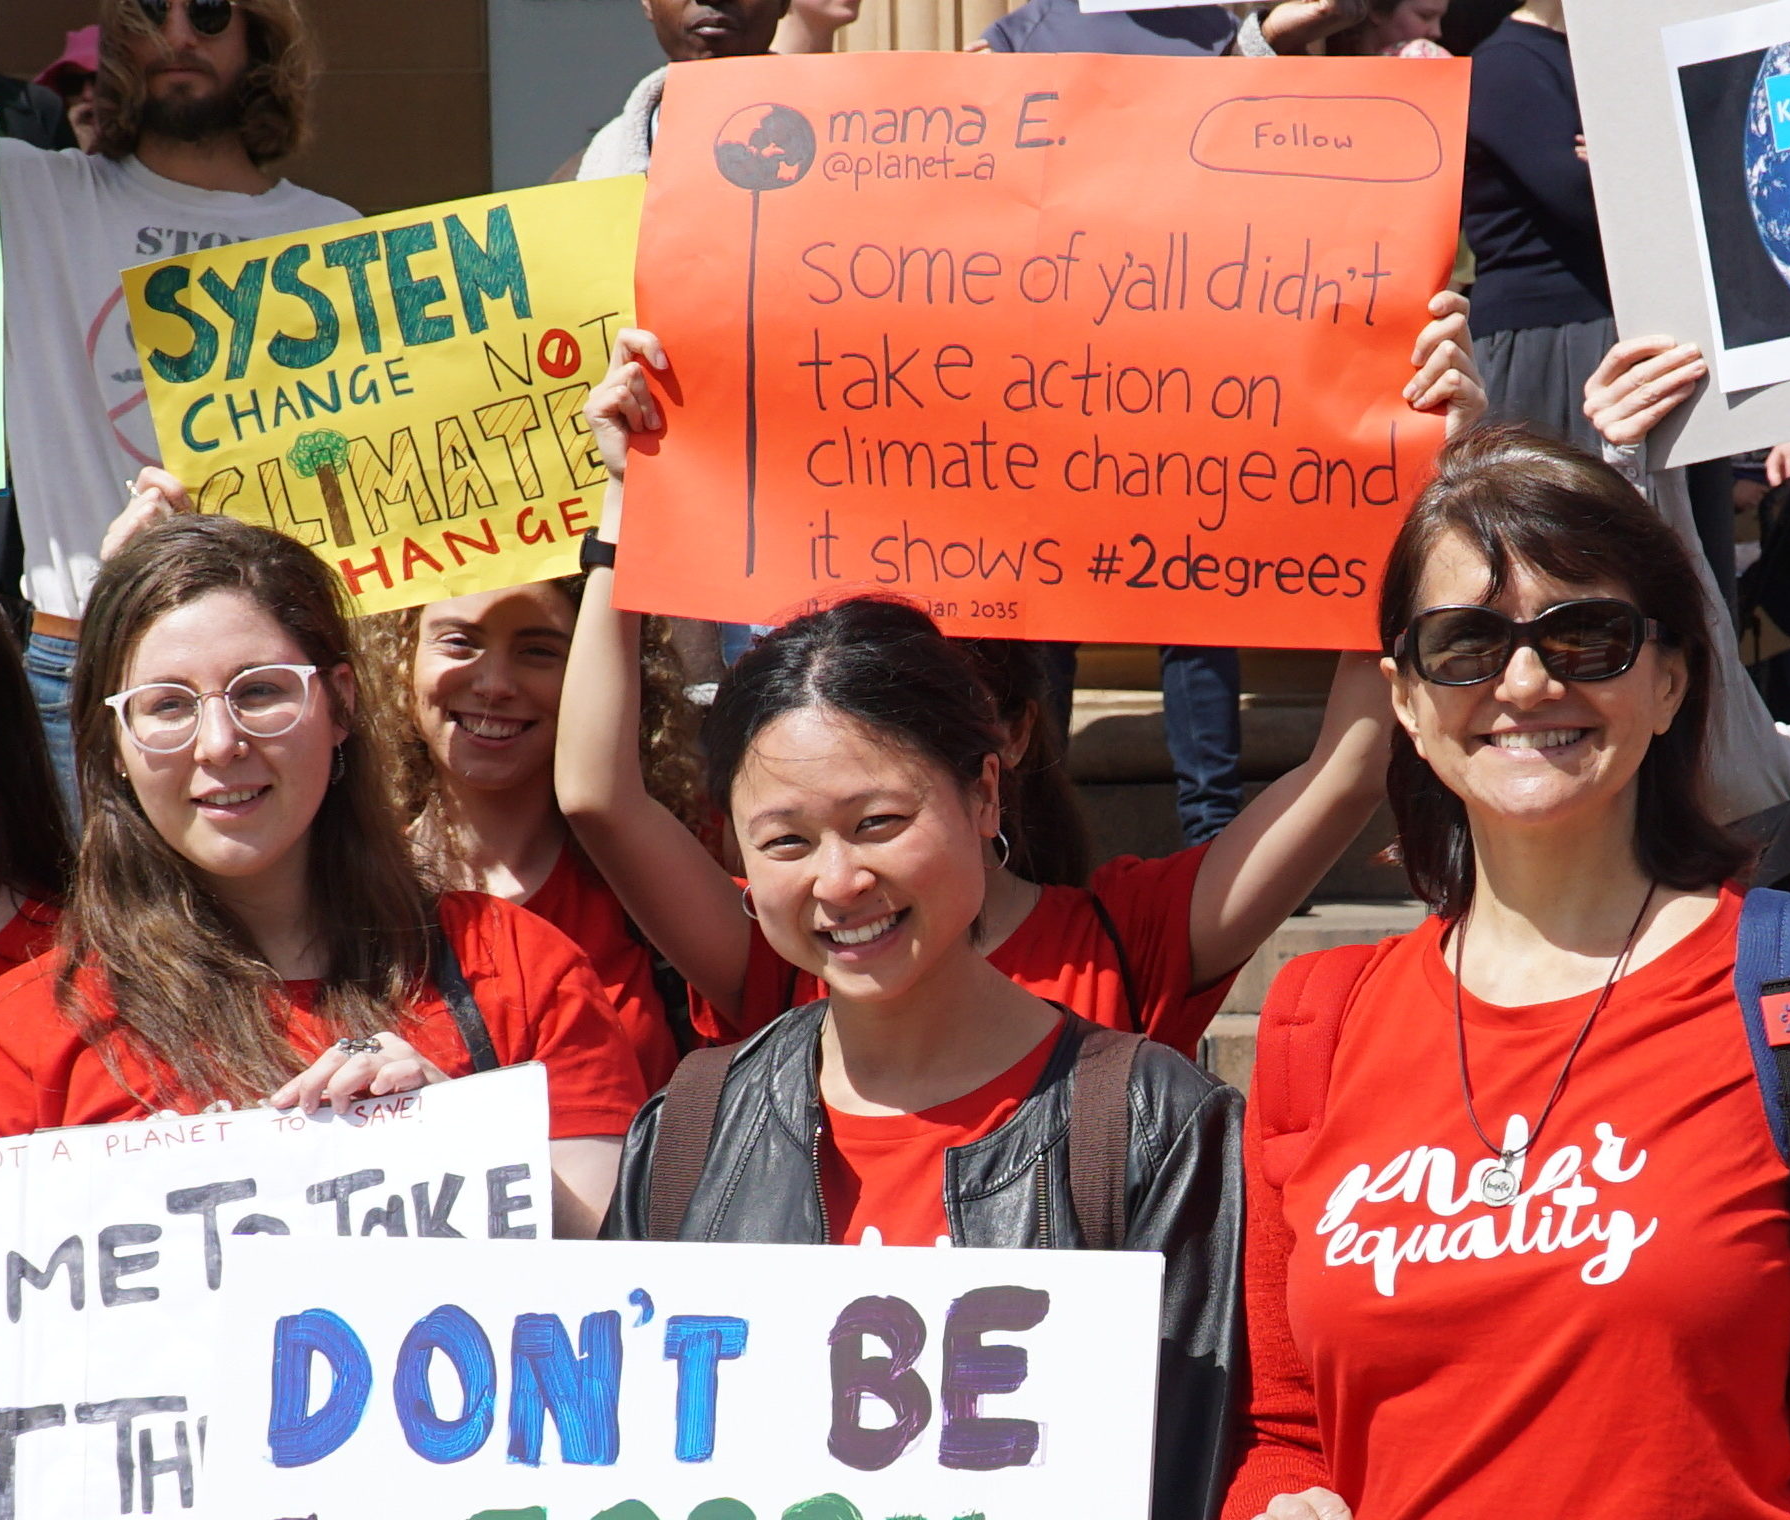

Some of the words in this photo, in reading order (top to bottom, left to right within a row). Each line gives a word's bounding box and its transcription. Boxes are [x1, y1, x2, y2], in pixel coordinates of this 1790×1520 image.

[828, 102, 988, 147] mama
[1015, 91, 1067, 149] E.
[1254, 121, 1353, 150] Follow
[821, 151, 996, 190] @planet_a
[136, 226, 254, 255] STO
[801, 240, 1003, 306] some
[1018, 230, 1087, 305] of
[1098, 231, 1189, 326] y'all
[1206, 223, 1393, 327] didn't
[143, 203, 533, 384] SYSTEM
[180, 357, 414, 453] CHANGE
[797, 332, 974, 412] take
[1003, 343, 1194, 416] action
[1211, 371, 1281, 427] on
[196, 382, 612, 550] CLIMATE
[807, 421, 1039, 493] climate
[1063, 434, 1278, 531] change
[1288, 420, 1400, 509] and
[337, 497, 598, 597] HANGE
[809, 510, 841, 583] it
[870, 517, 1062, 587] shows
[1088, 534, 1368, 600] #2degrees
[970, 600, 1019, 619] 2035
[51, 1138, 73, 1163] A
[105, 1121, 234, 1157] PLANET
[271, 1116, 306, 1132] TO
[354, 1095, 425, 1129] SAVE!
[1316, 1113, 1647, 1235] gender
[1325, 1172, 1659, 1297] equality
[263, 1287, 750, 1469] DON'T
[826, 1285, 1050, 1472] BE
[75, 1395, 206, 1515] TH
